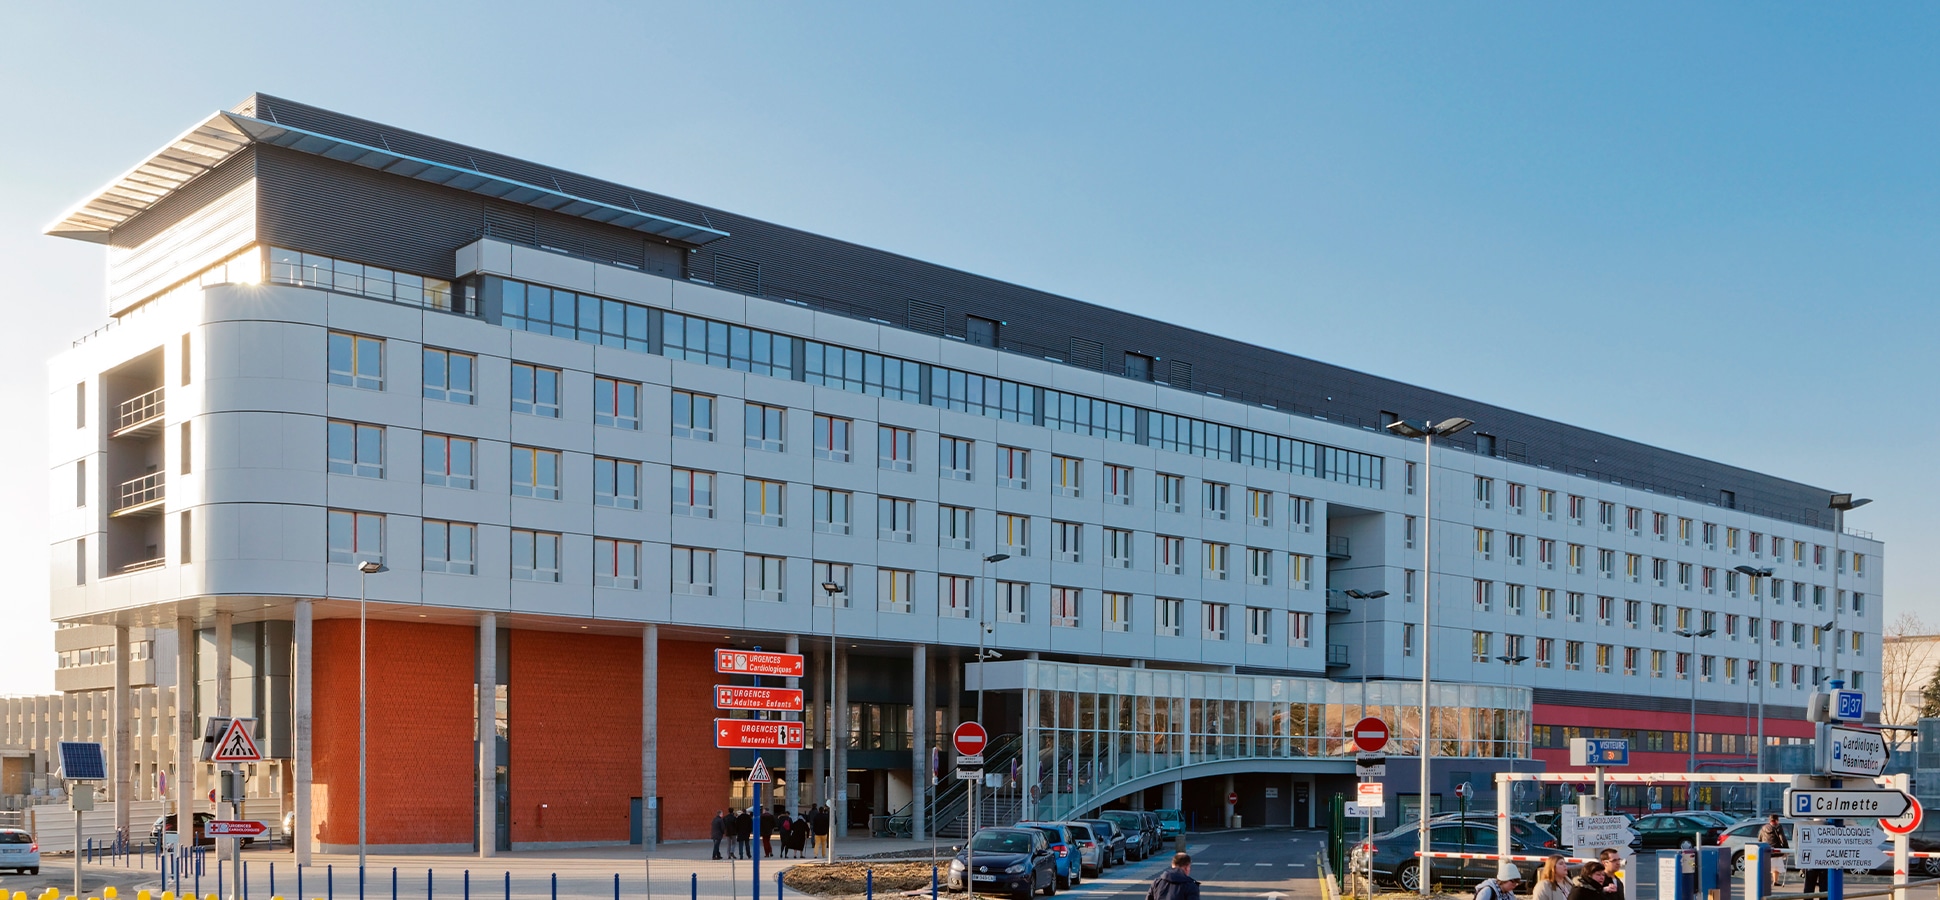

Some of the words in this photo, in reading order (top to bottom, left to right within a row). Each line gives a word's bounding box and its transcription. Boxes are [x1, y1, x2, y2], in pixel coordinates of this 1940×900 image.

[750, 655, 781, 664] URGENCES
[750, 664, 792, 673] Cardiologiques
[734, 690, 771, 698] URGENCES
[766, 700, 792, 708] Enfants
[1841, 698, 1848, 712] P
[1850, 698, 1861, 713] 37
[741, 725, 778, 733] URGENCES
[741, 736, 775, 744] Maternité
[1600, 741, 1625, 750] VISITEURS
[1842, 736, 1880, 756] Cardiologie
[1587, 741, 1596, 762] P
[1592, 755, 1600, 763] 37
[1842, 754, 1879, 770] Réanimation
[1799, 796, 1809, 811] P
[1816, 797, 1878, 811] Calmette
[1825, 849, 1860, 858] CALMETTE
